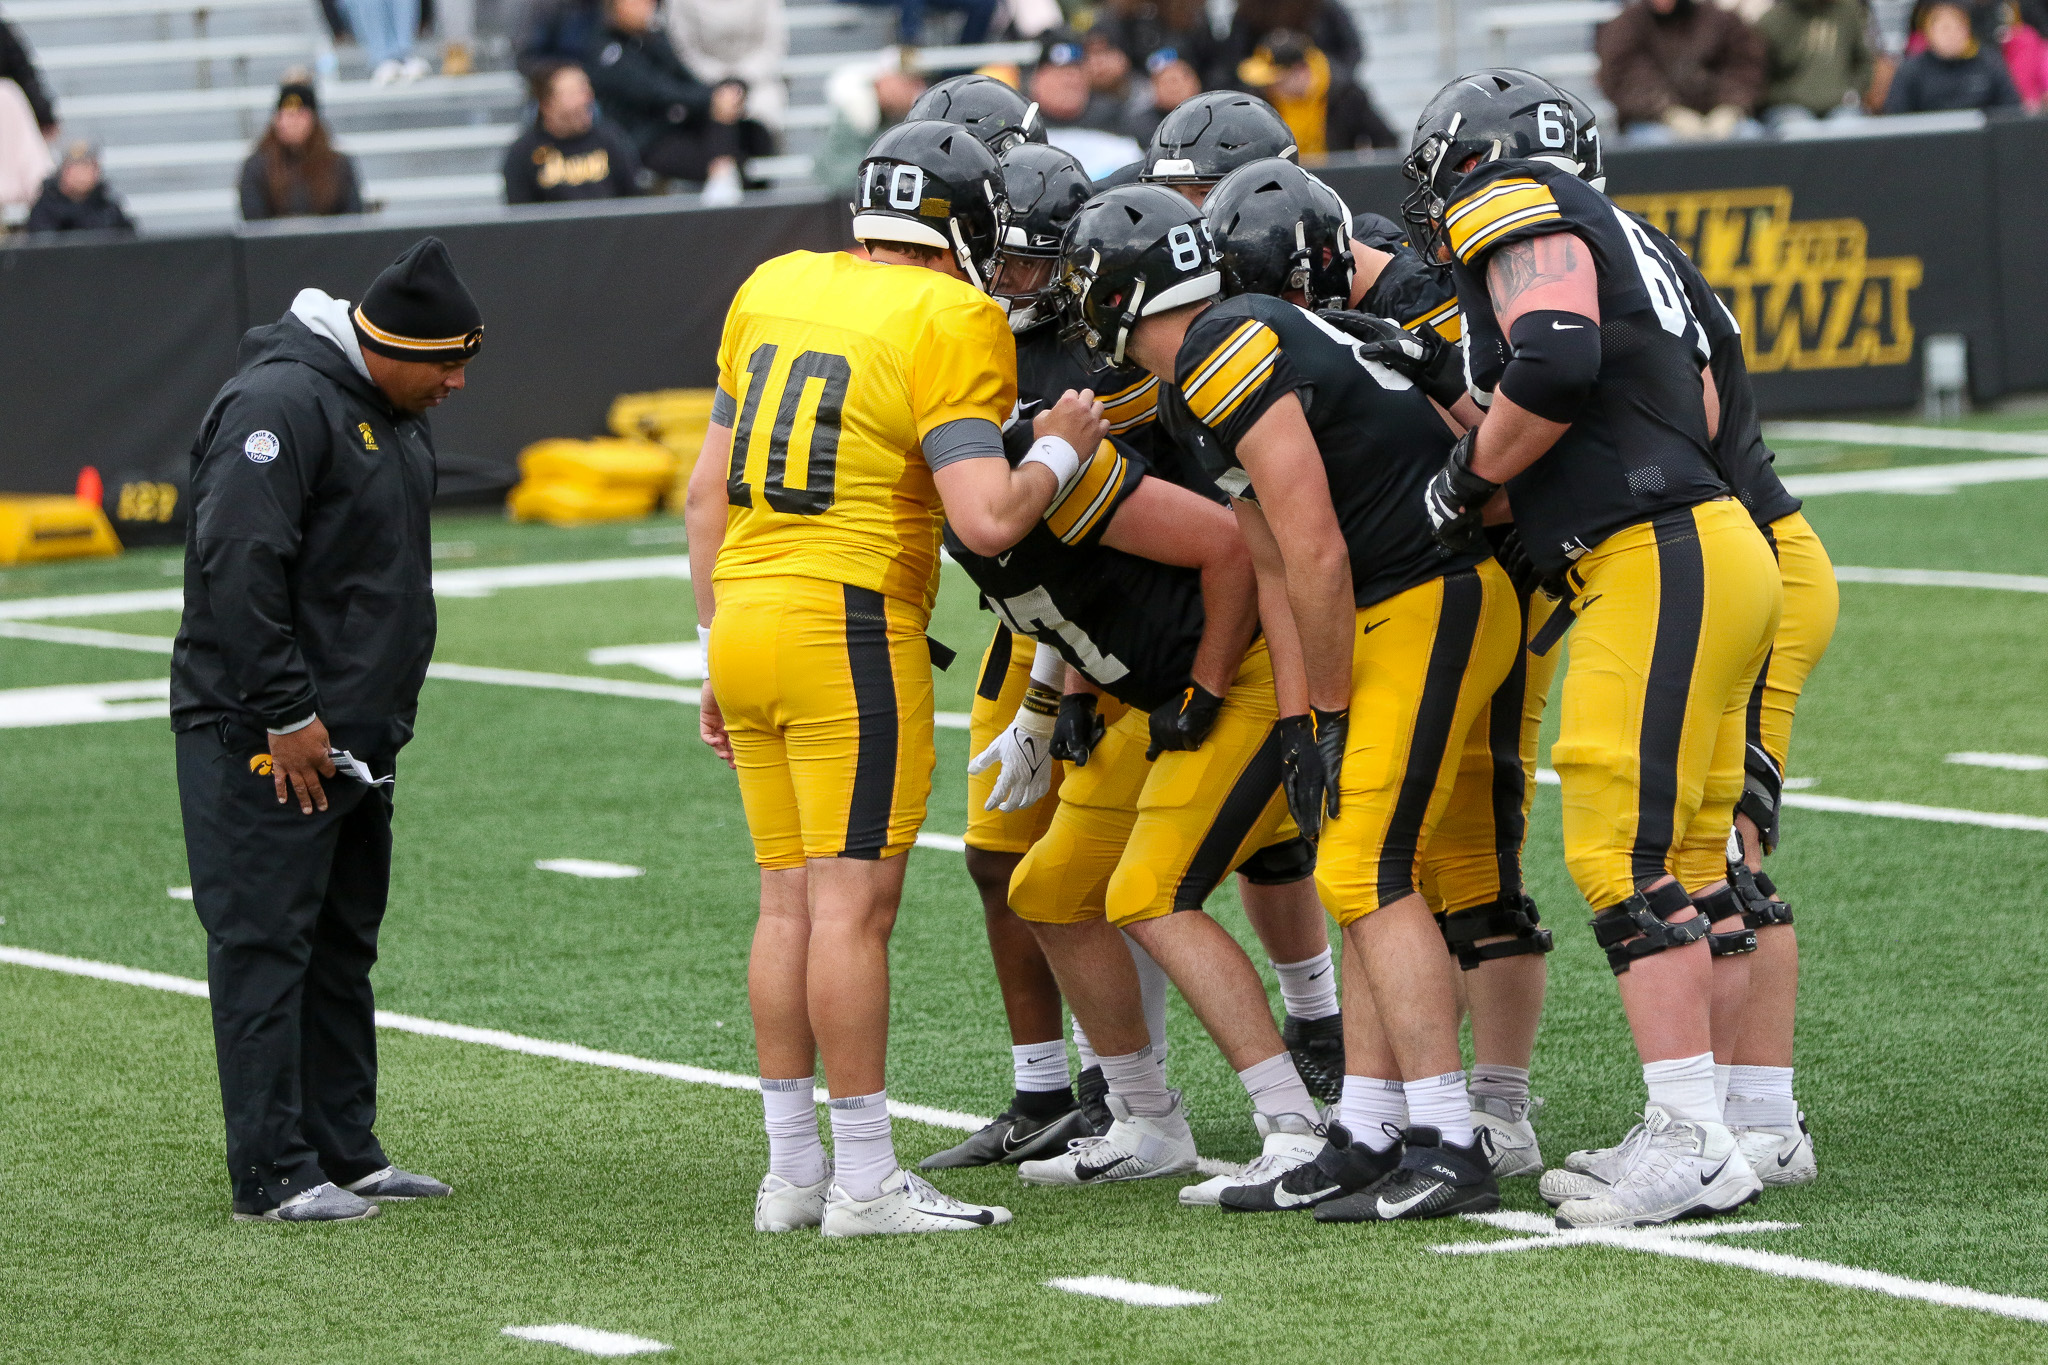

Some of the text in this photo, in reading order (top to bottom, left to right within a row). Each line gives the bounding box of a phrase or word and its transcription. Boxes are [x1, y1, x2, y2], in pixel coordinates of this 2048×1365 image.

[863, 162, 923, 210] 10
[727, 343, 851, 515] 10
[1561, 541, 1575, 552] XL
[1490, 1127, 1512, 1143] ALPHA
[1291, 1146, 1315, 1158] ALPHA
[1432, 1164, 1458, 1180] ALPHA
